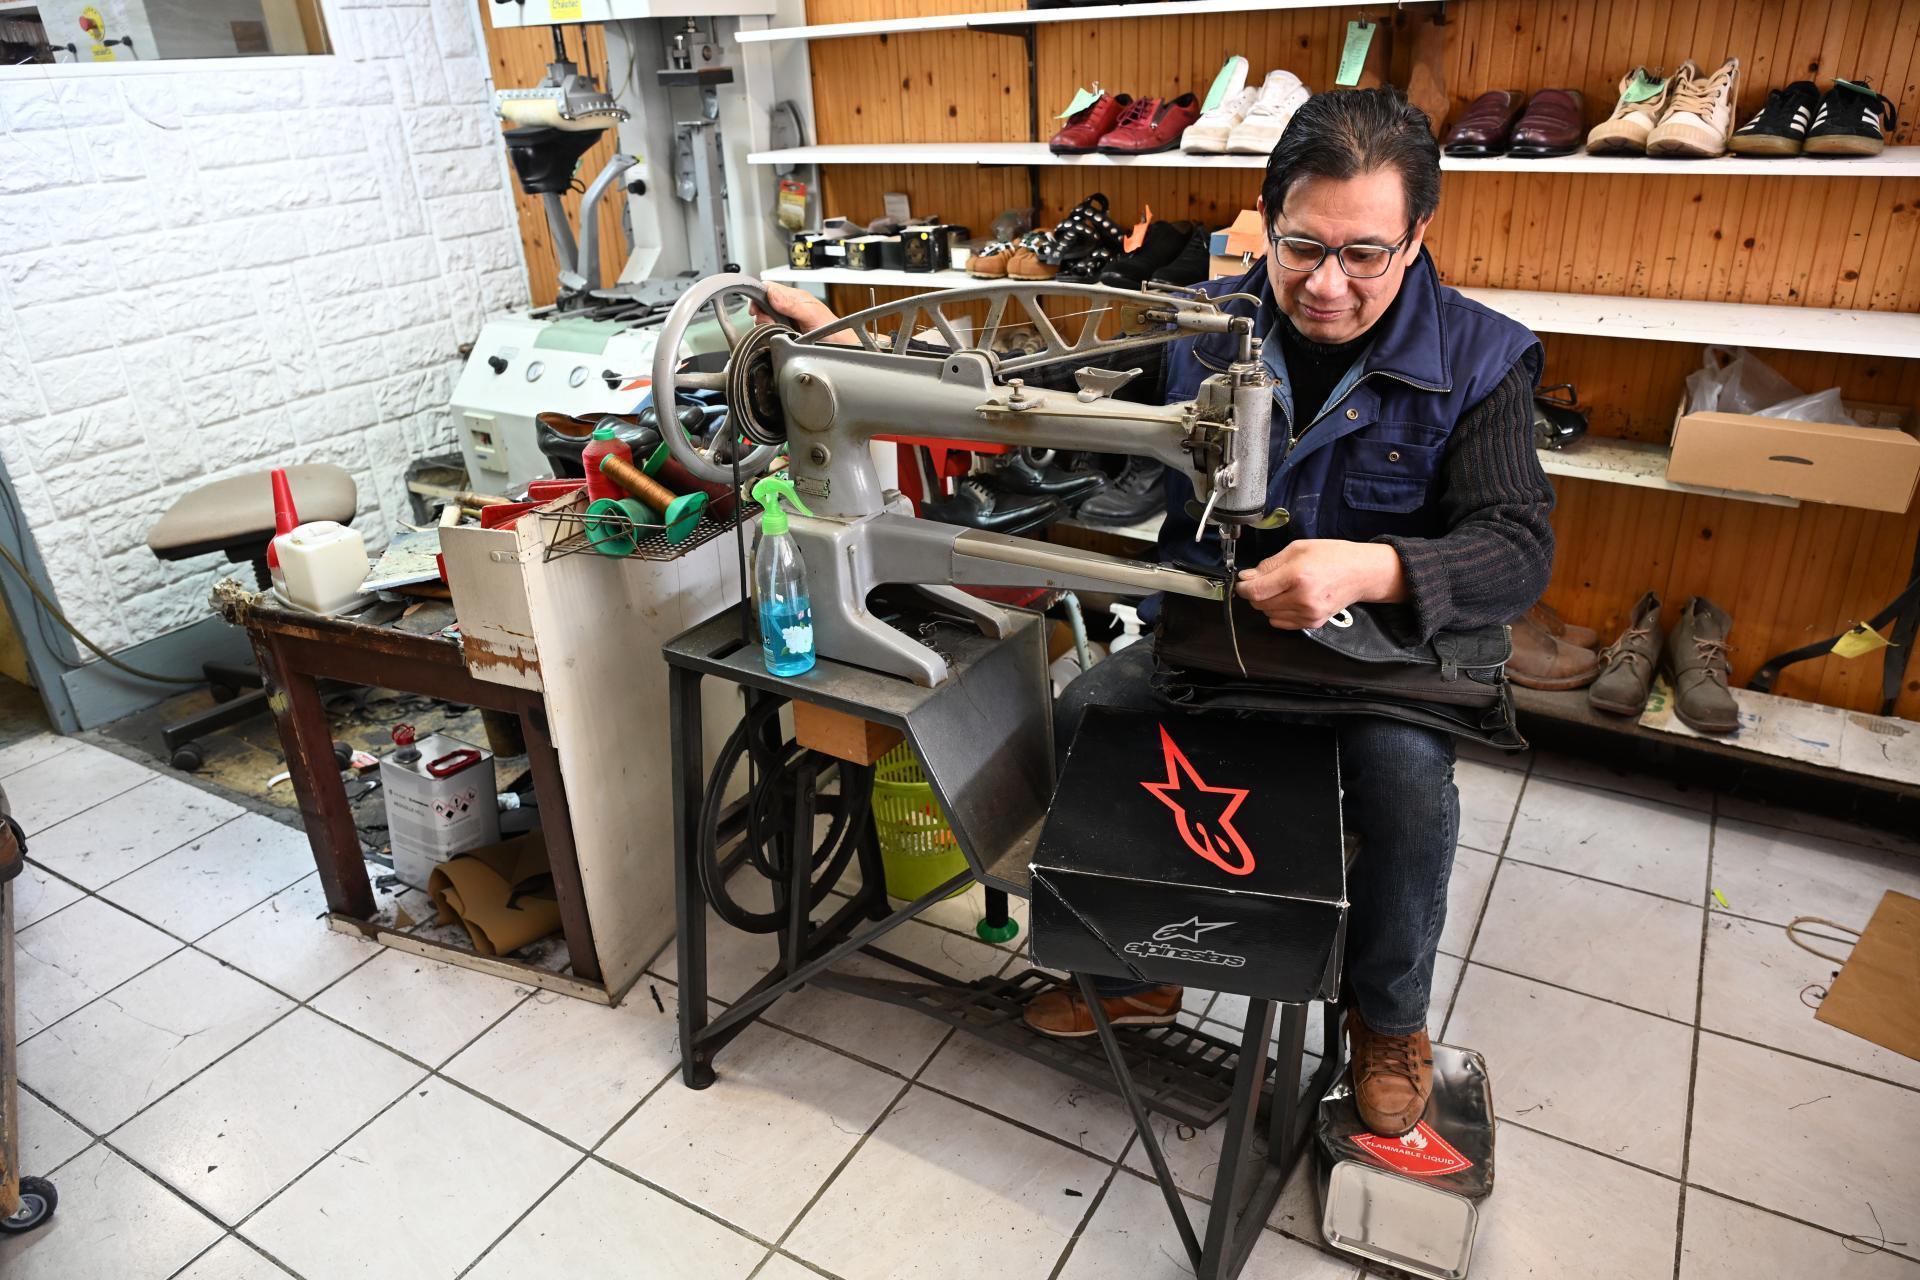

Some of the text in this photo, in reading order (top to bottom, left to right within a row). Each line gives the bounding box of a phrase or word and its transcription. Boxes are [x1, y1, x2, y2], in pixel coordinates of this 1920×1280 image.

[1124, 941, 1246, 967] alpinestars
[1366, 1141, 1455, 1165] FLAMMABLE LIQUID
